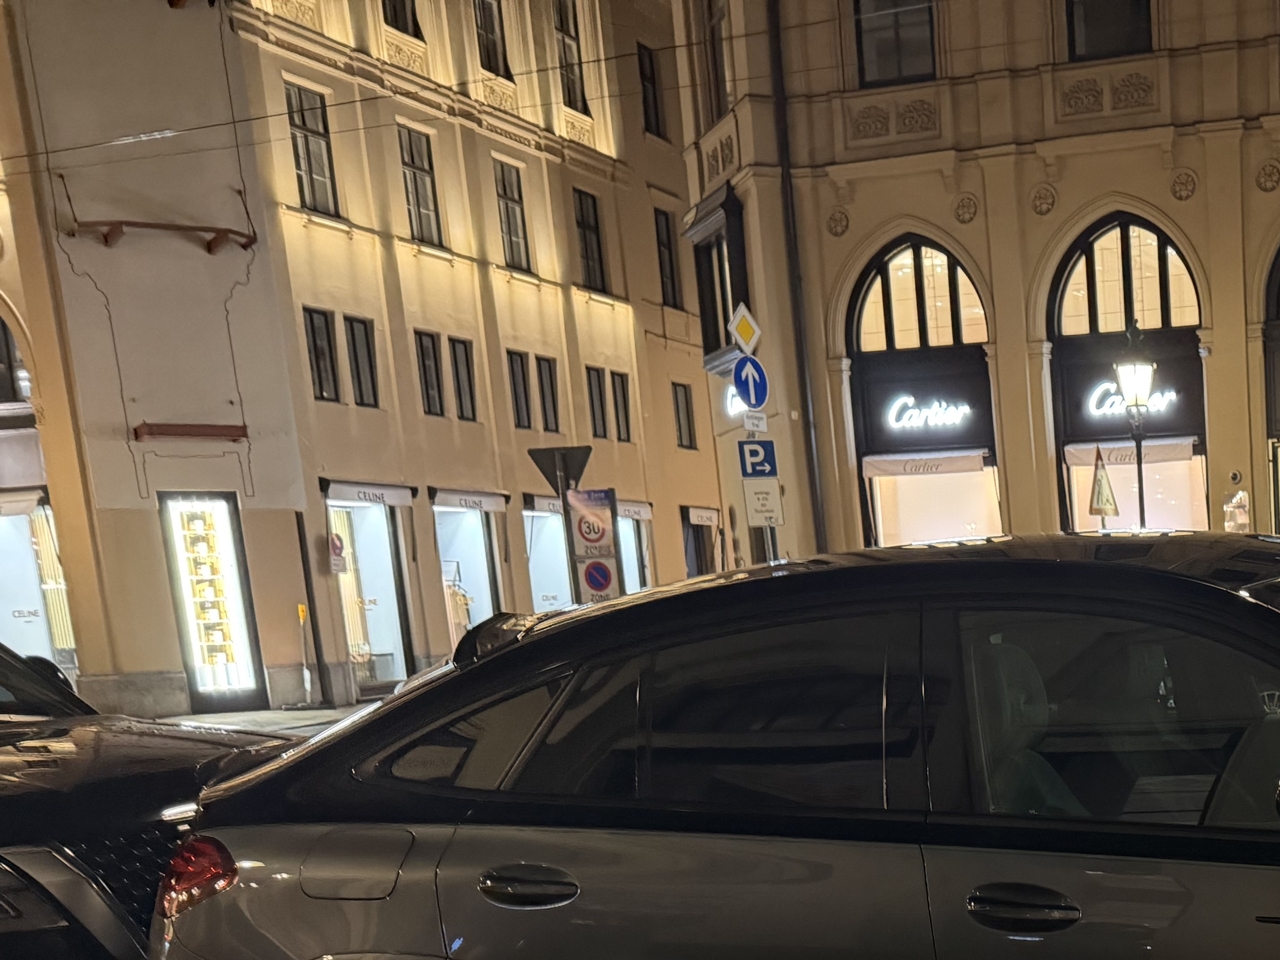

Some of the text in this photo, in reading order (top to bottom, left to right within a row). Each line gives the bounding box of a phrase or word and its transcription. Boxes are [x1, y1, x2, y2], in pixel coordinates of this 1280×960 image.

[888, 395, 971, 428] Cartier
[743, 444, 765, 474] P
[903, 460, 942, 472] Cartier
[357, 490, 386, 502] CELINE
[459, 498, 484, 509] CELINE
[624, 508, 642, 518] CELINE
[12, 609, 40, 619] CELINE
